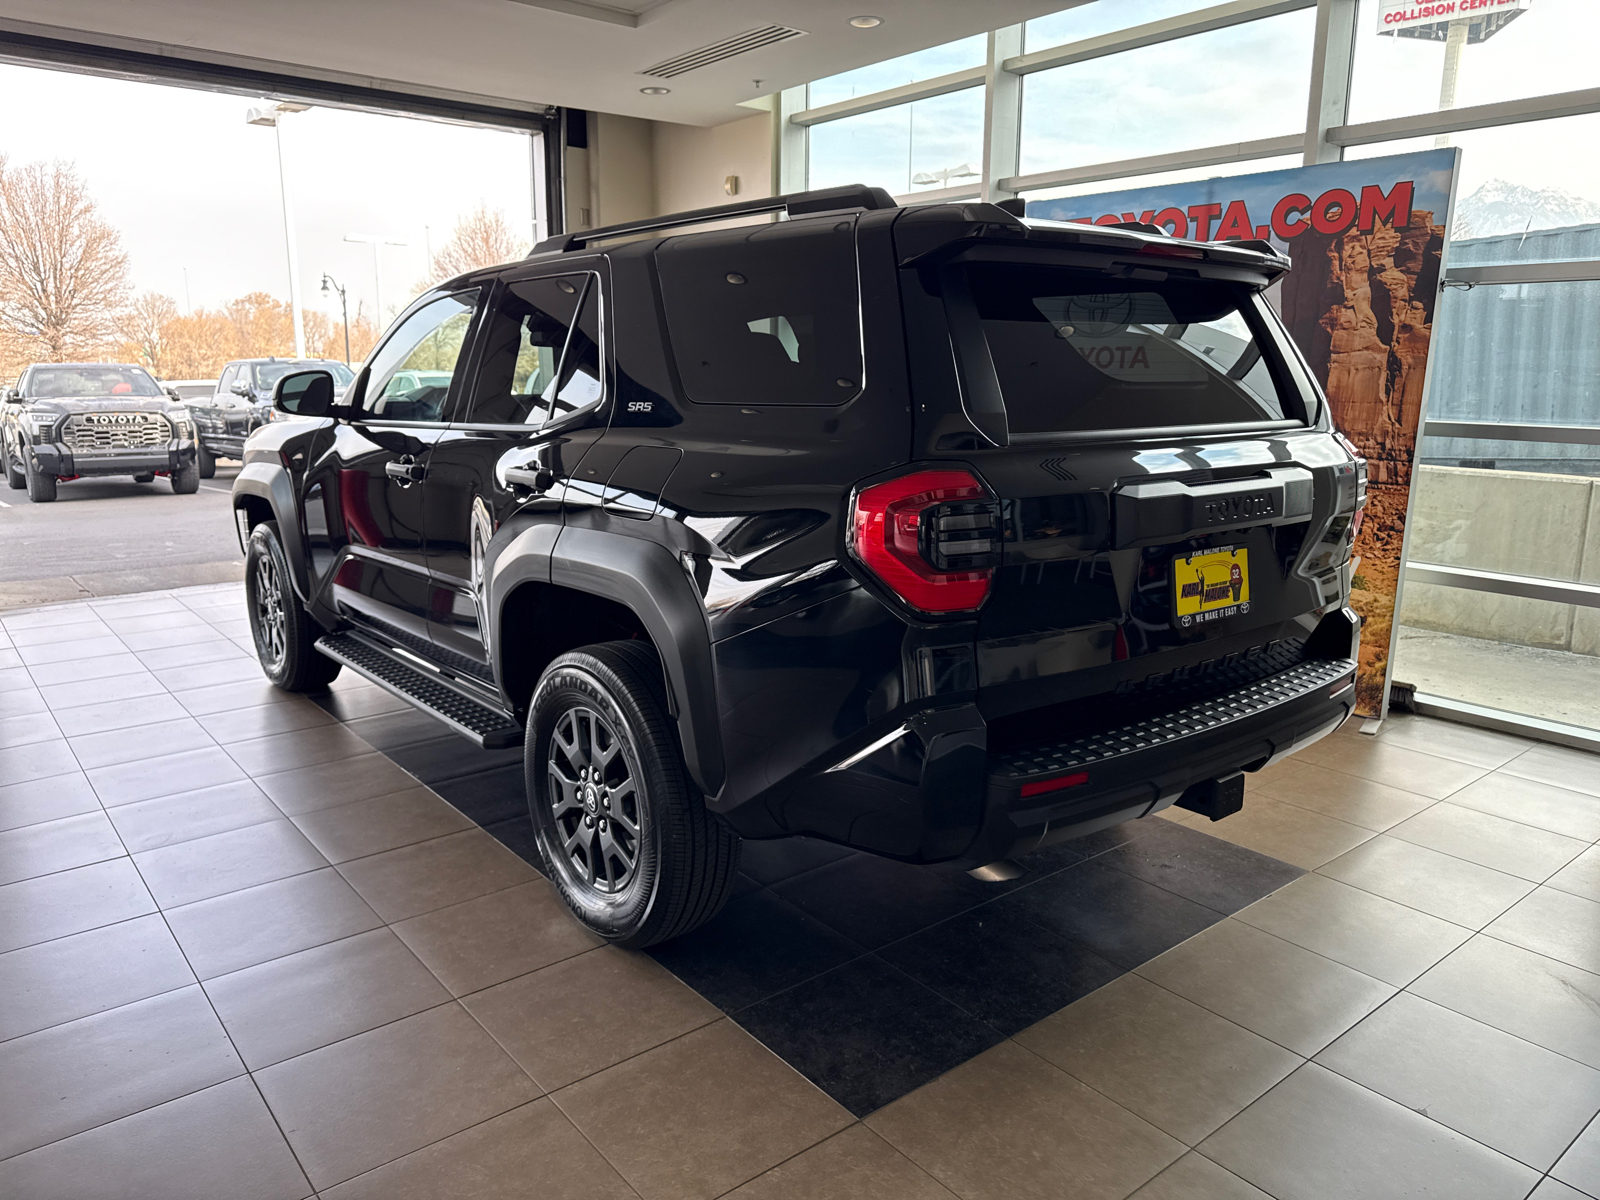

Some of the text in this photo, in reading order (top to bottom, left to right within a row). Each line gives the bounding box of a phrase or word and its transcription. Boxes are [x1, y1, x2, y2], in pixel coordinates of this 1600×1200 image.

[1384, 2, 1455, 24] COLLISION
[627, 401, 653, 413] SR5
[91, 415, 143, 425] TOYOTA
[1205, 492, 1275, 522] TOYOTA
[1232, 568, 1240, 579] 32
[1195, 606, 1237, 623] WE MAKE IT EASY
[534, 676, 610, 713] GEOLANDAR
